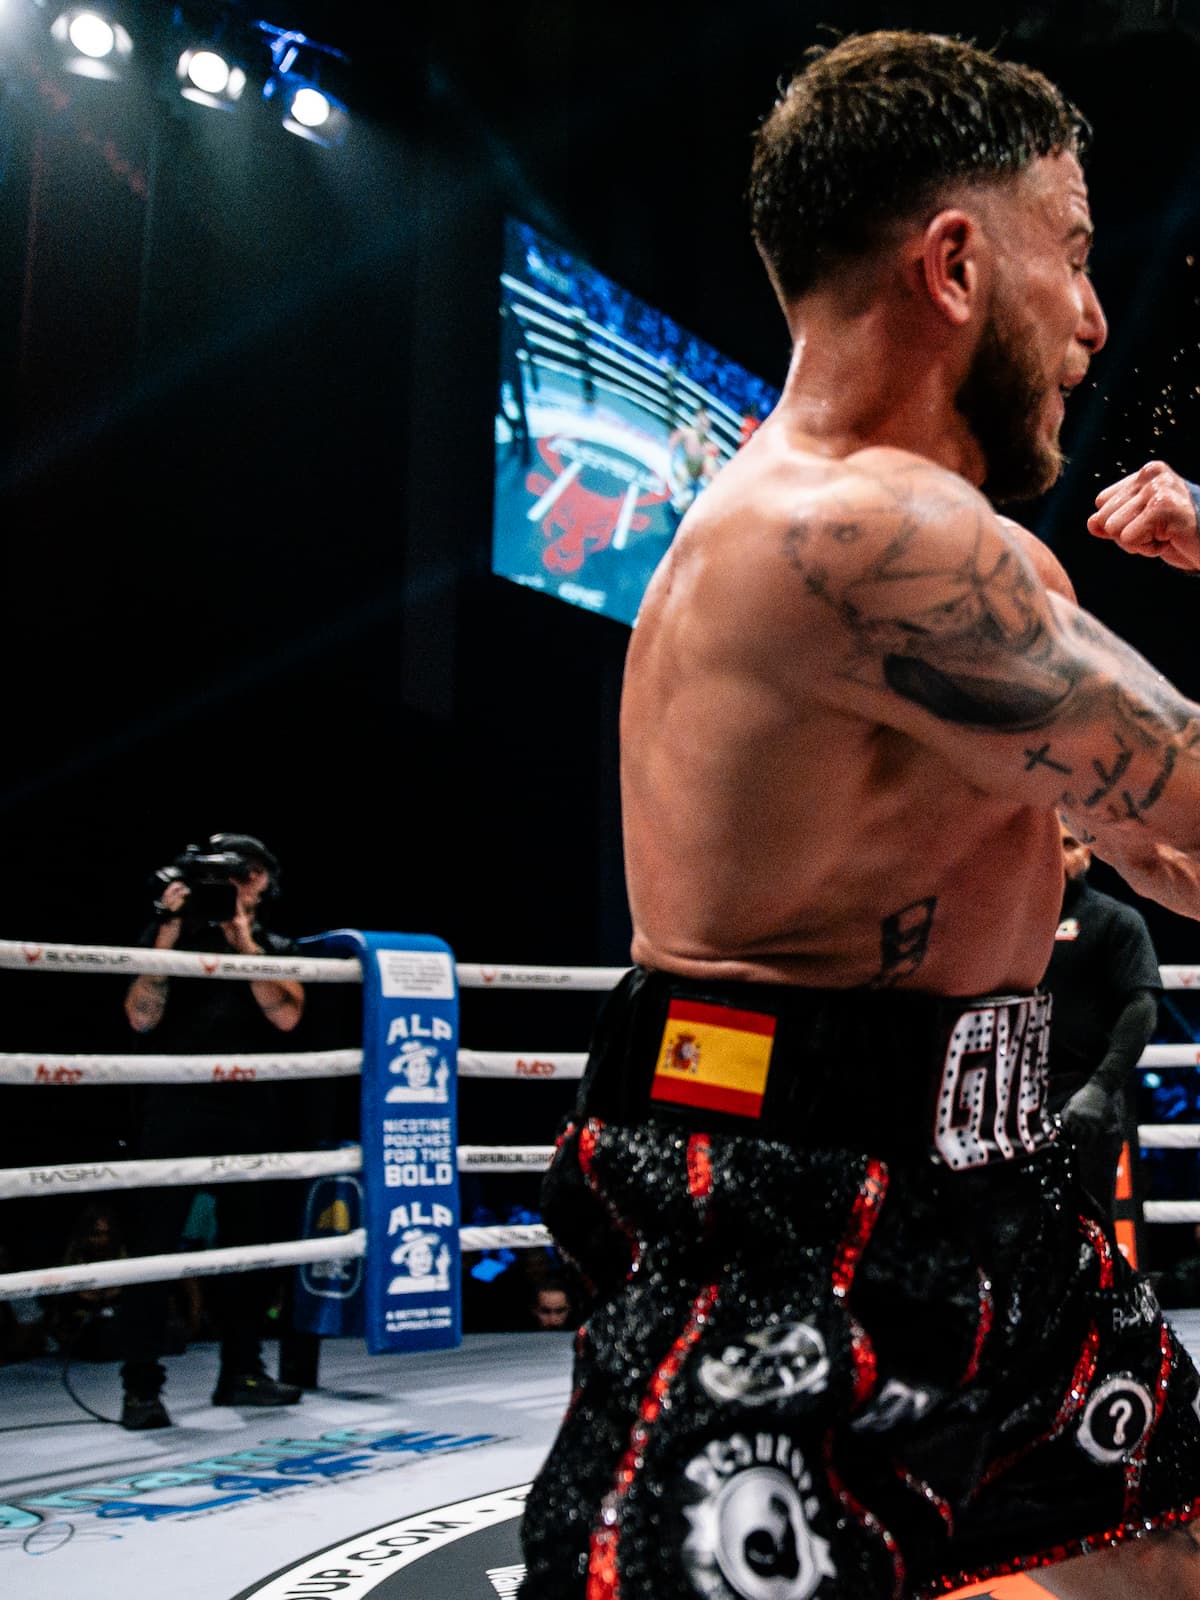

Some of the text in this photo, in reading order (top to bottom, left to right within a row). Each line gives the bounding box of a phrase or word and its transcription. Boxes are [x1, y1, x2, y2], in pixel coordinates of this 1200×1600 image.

[383, 1118, 451, 1133] NICOTINE
[383, 1133, 452, 1148] POUCHES
[383, 1148, 417, 1164] FOR
[420, 1147, 452, 1162] THE
[384, 1163, 453, 1188] BOLD
